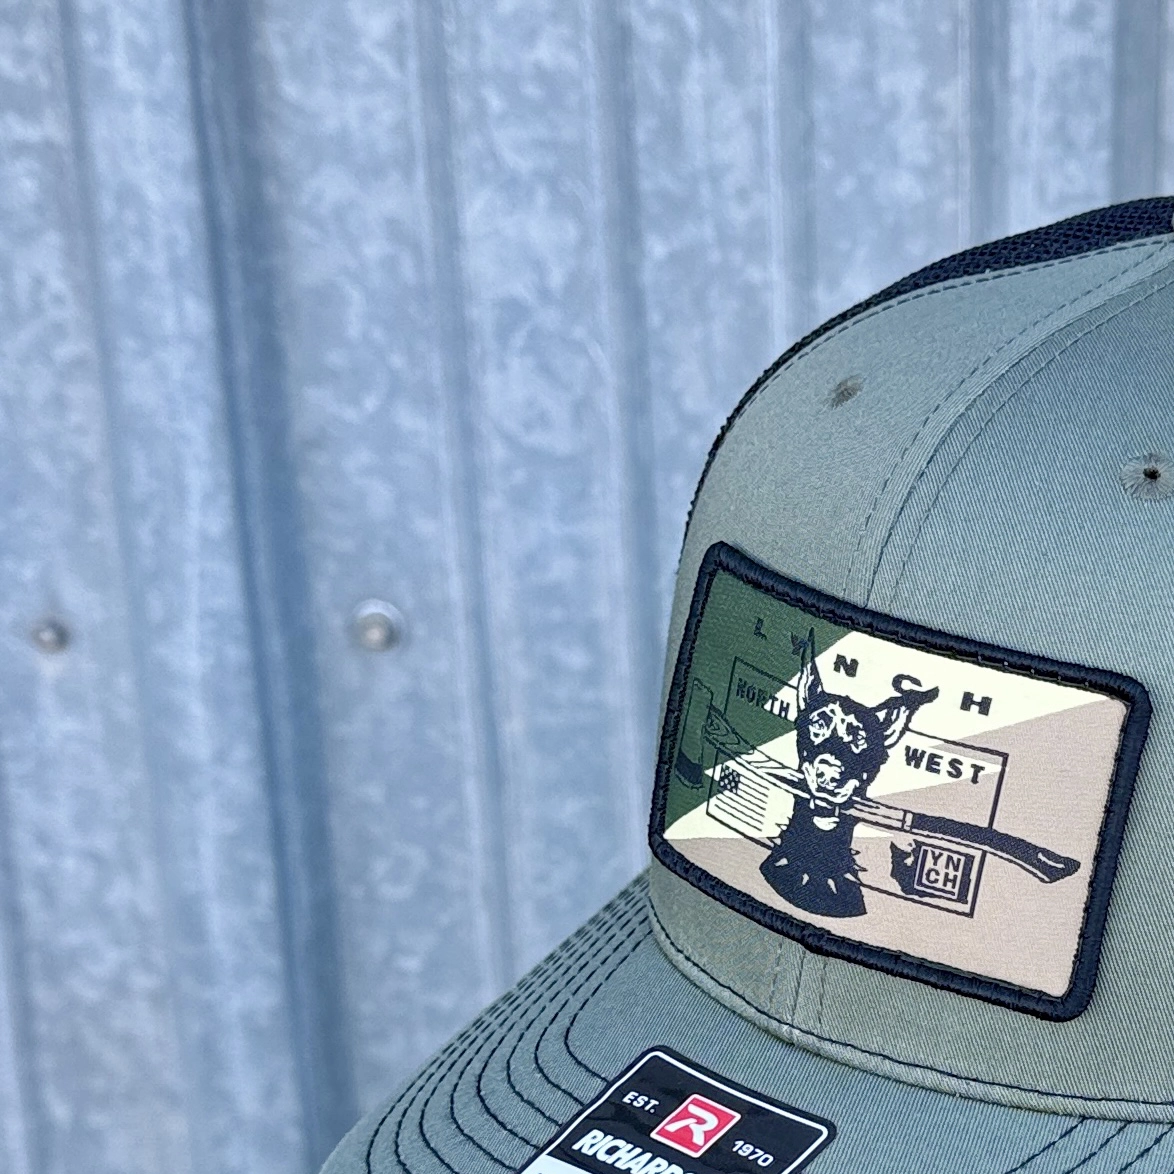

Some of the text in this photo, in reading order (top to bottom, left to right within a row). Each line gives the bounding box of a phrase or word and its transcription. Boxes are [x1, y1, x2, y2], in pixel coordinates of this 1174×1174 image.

[735, 677, 791, 721] NORTH
[904, 745, 986, 785] WEST
[622, 1091, 660, 1114] EST.
[732, 1140, 774, 1167] 1970
